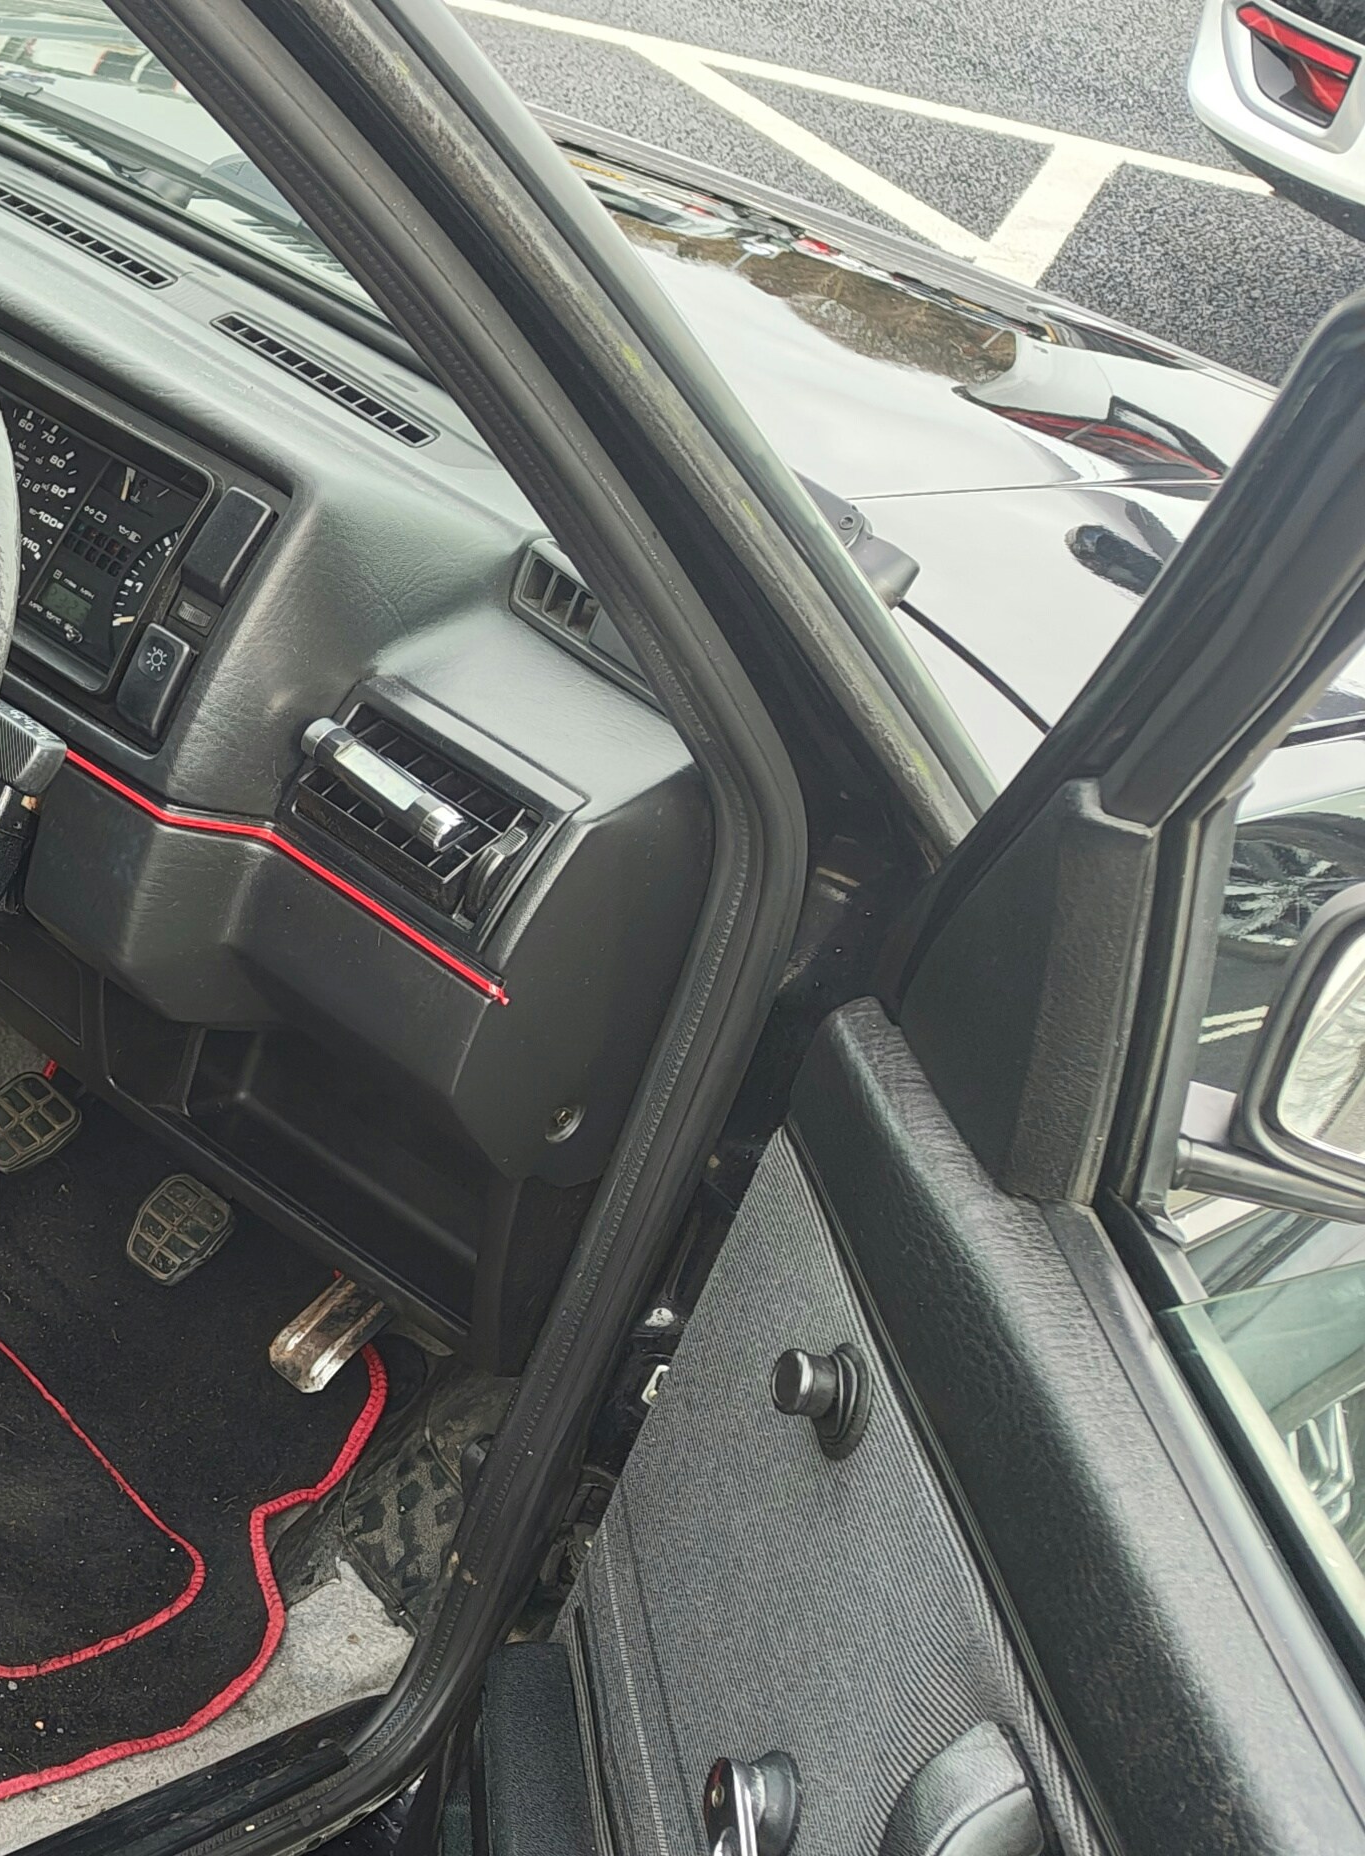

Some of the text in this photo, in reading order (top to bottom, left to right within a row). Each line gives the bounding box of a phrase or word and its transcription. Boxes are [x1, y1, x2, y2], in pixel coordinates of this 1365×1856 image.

[18, 418, 34, 432] 60
[41, 430, 56, 444] 70
[49, 454, 66, 468] 80
[39, 511, 58, 527] 100
[22, 537, 40, 552] 110
[135, 581, 144, 593] 1
